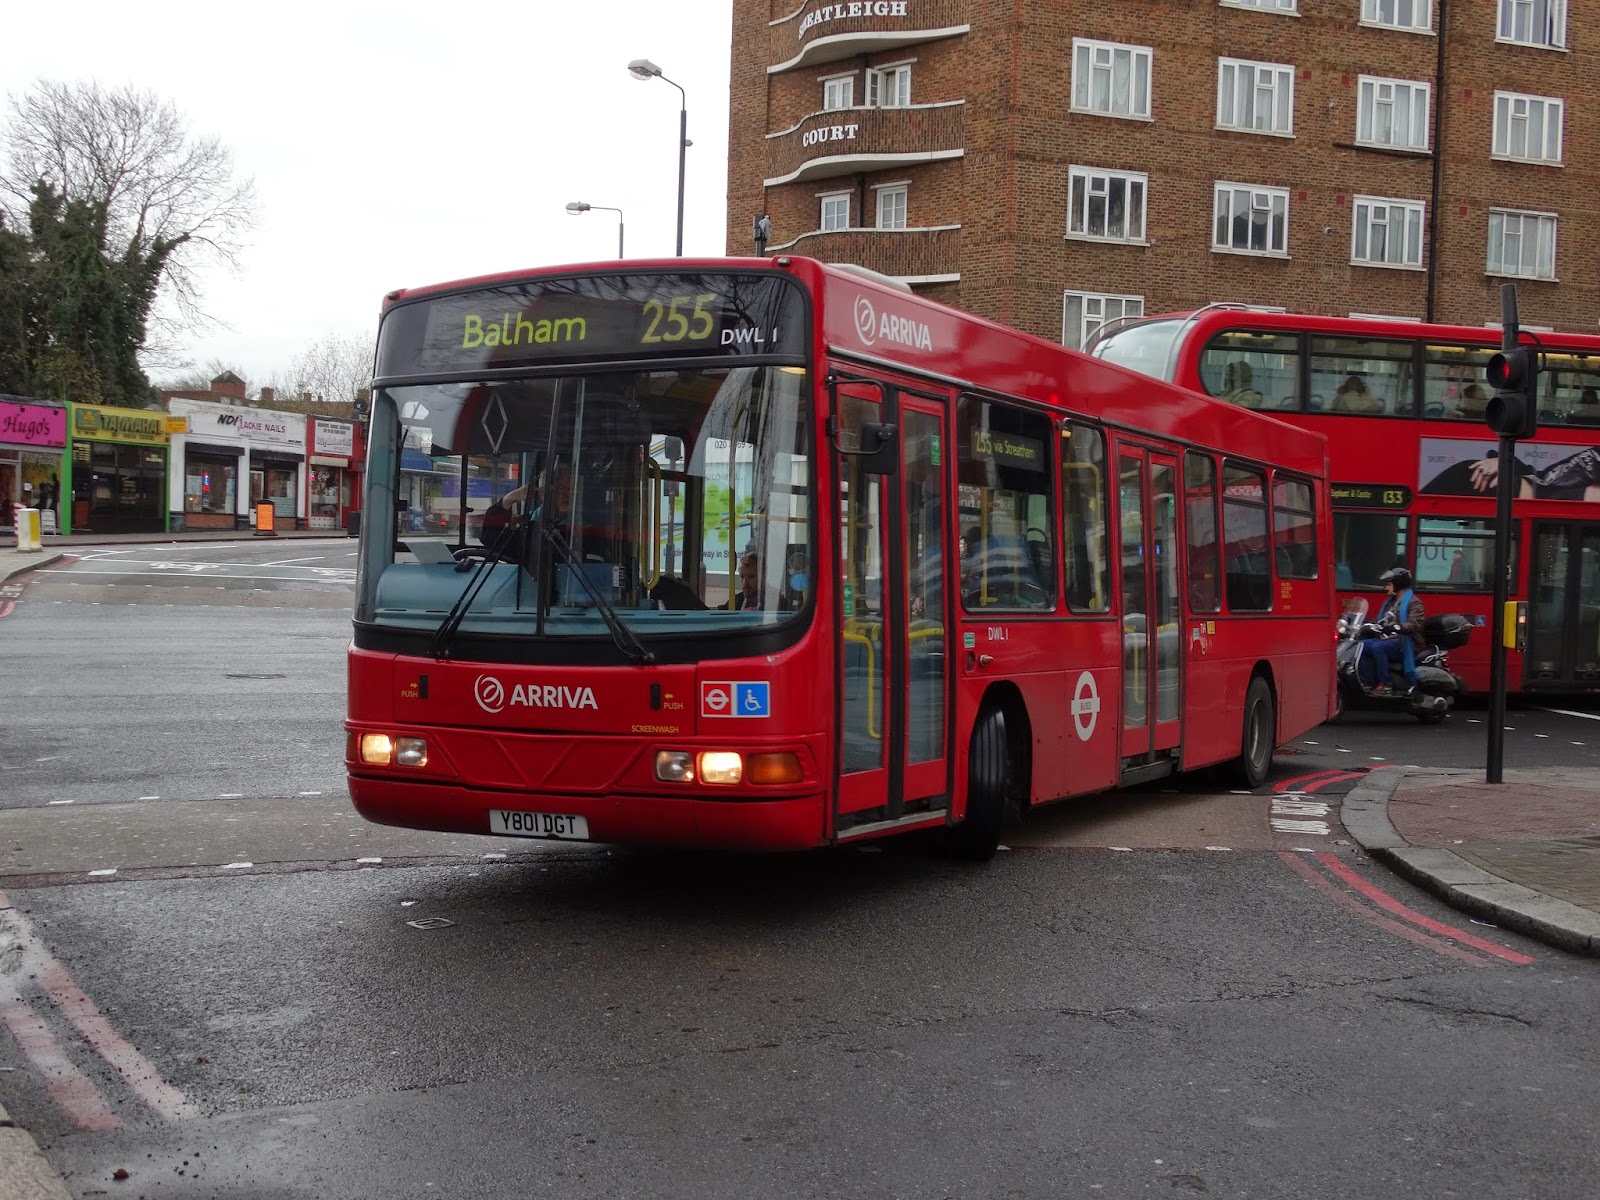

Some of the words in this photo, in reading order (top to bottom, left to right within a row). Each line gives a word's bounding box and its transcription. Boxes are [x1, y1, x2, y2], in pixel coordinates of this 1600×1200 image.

[802, 124, 859, 148] COURT
[462, 311, 587, 348] Balham
[640, 293, 718, 344] 255
[878, 311, 933, 351] ARRIVA
[720, 328, 765, 346] DWL
[2, 414, 51, 439] Hugo's
[120, 416, 164, 435] MAHAL
[264, 423, 286, 434] NAILS
[974, 431, 993, 455] 255
[1004, 440, 1035, 459] Streatham
[1383, 490, 1403, 504] 133
[401, 690, 418, 698] PUSH
[509, 682, 599, 711] ARRIVA
[663, 701, 684, 710] PUSH
[631, 724, 680, 734] SCREENWASH
[500, 811, 539, 832] Y801
[542, 814, 576, 835] DGT
